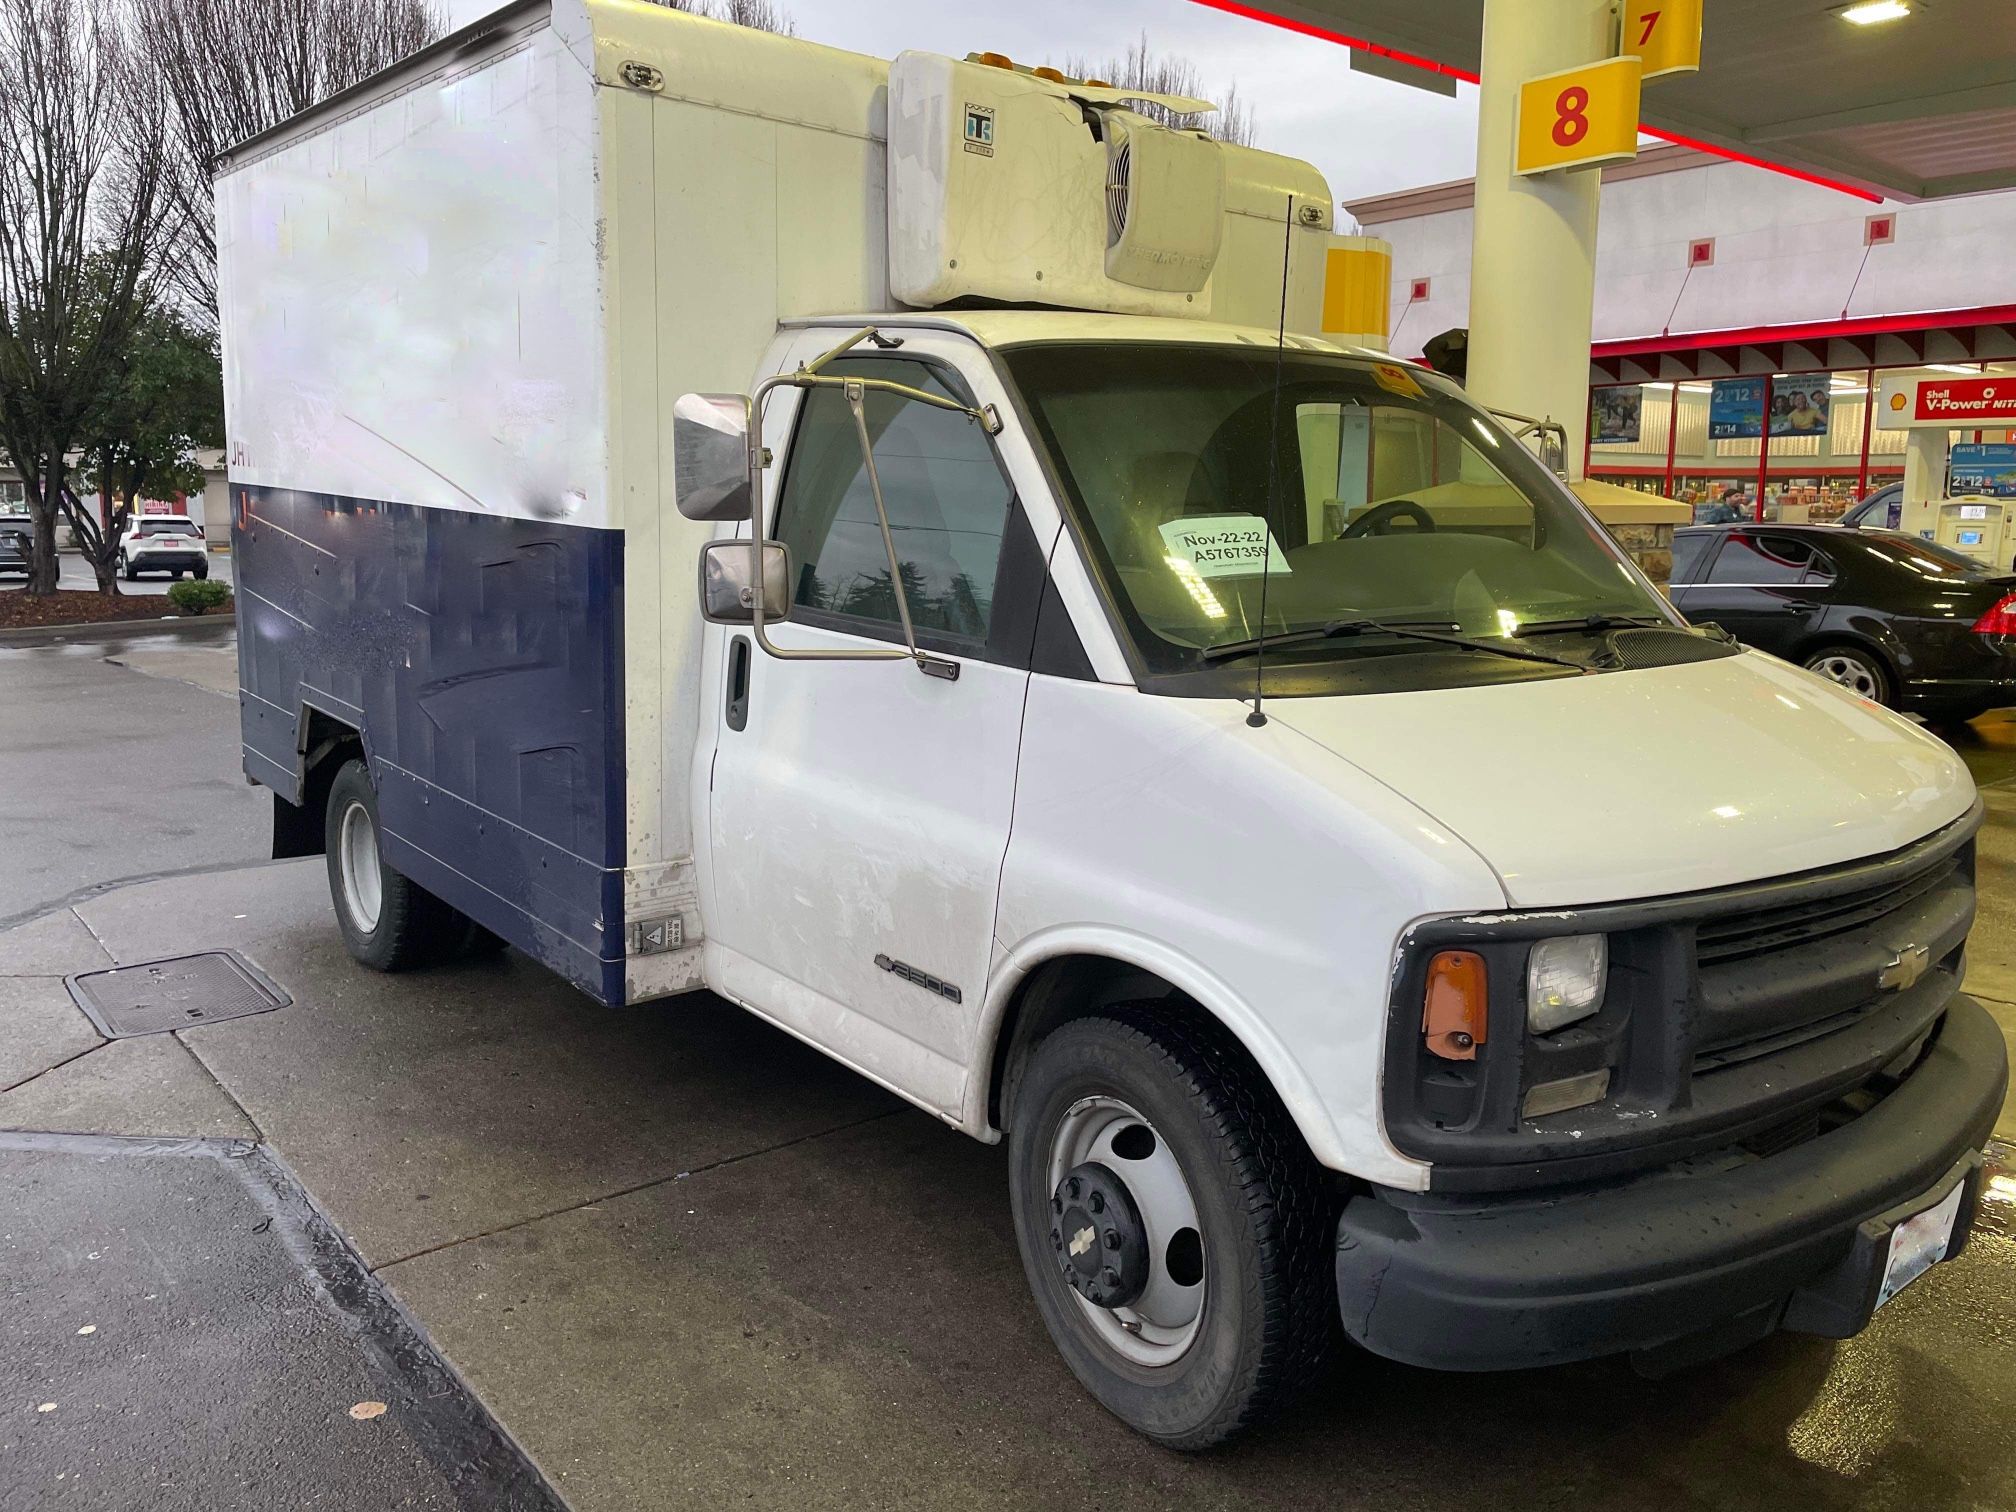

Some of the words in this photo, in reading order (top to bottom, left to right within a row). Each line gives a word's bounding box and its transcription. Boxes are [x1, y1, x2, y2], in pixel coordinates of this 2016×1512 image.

[1638, 11, 1661, 46] 7
[1552, 86, 1589, 147] 8
[1926, 389, 1950, 399] Shell
[1926, 400, 1989, 410] V-Power
[1183, 532, 1264, 548] Nov-22-22
[1195, 546, 1269, 563] A5767359
